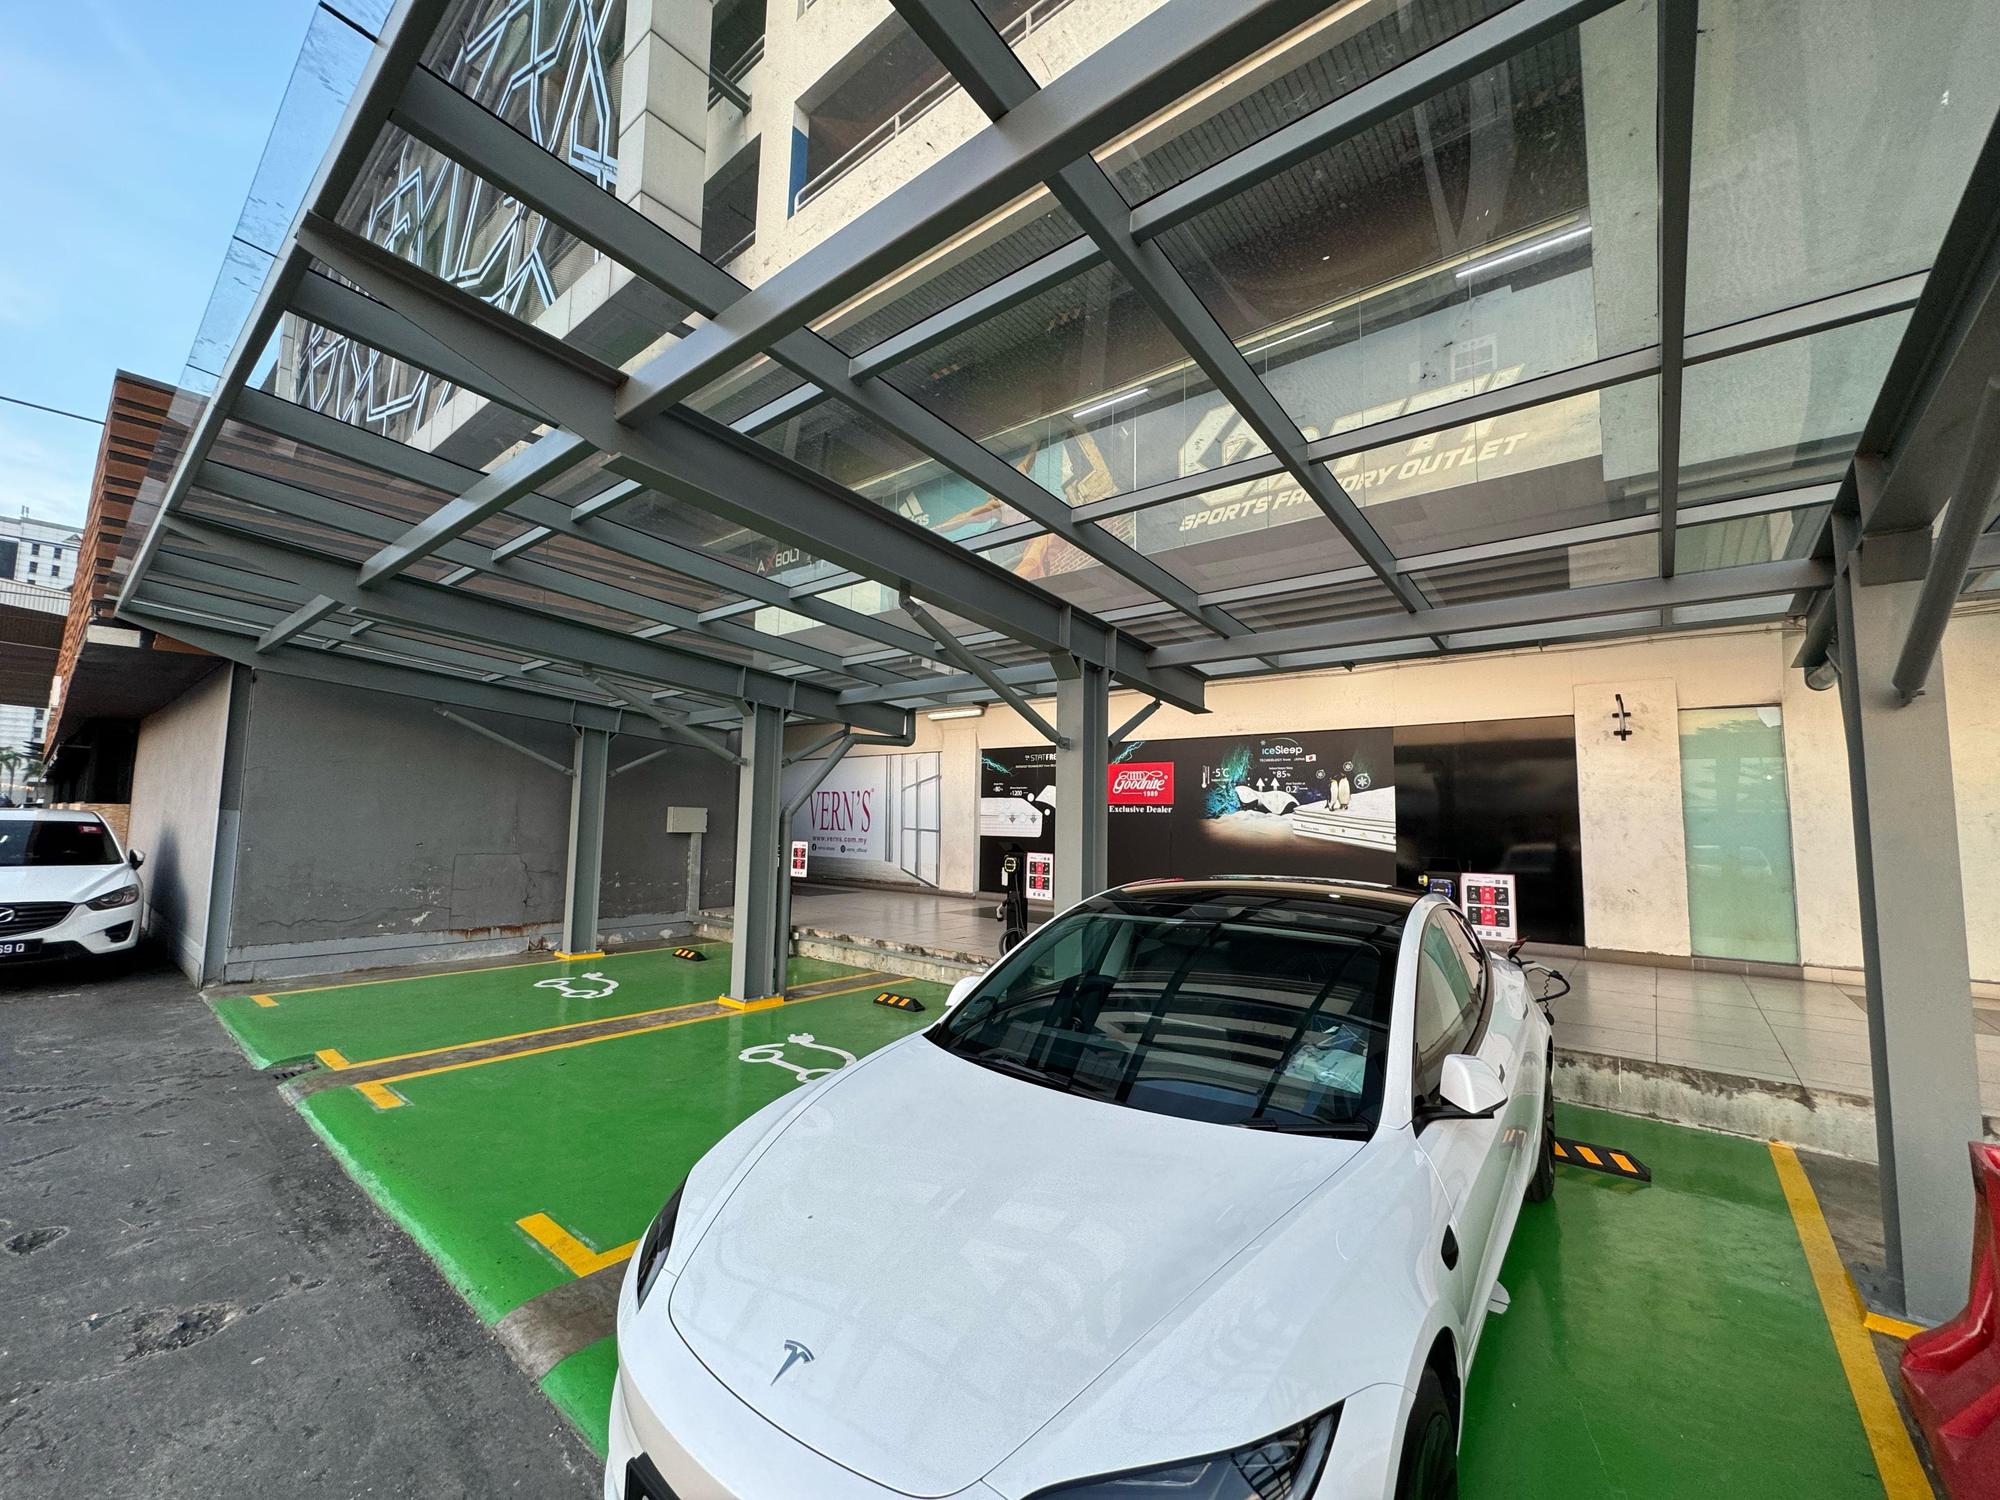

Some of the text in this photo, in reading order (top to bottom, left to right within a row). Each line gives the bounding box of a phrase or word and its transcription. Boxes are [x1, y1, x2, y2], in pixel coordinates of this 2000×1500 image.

[1179, 432, 1527, 531] SPORTS FAORY OUTLET
[1261, 745, 1303, 756] iceSleep
[810, 790, 871, 832] VERN'S
[1109, 805, 1173, 813] Exclusive Dealer
